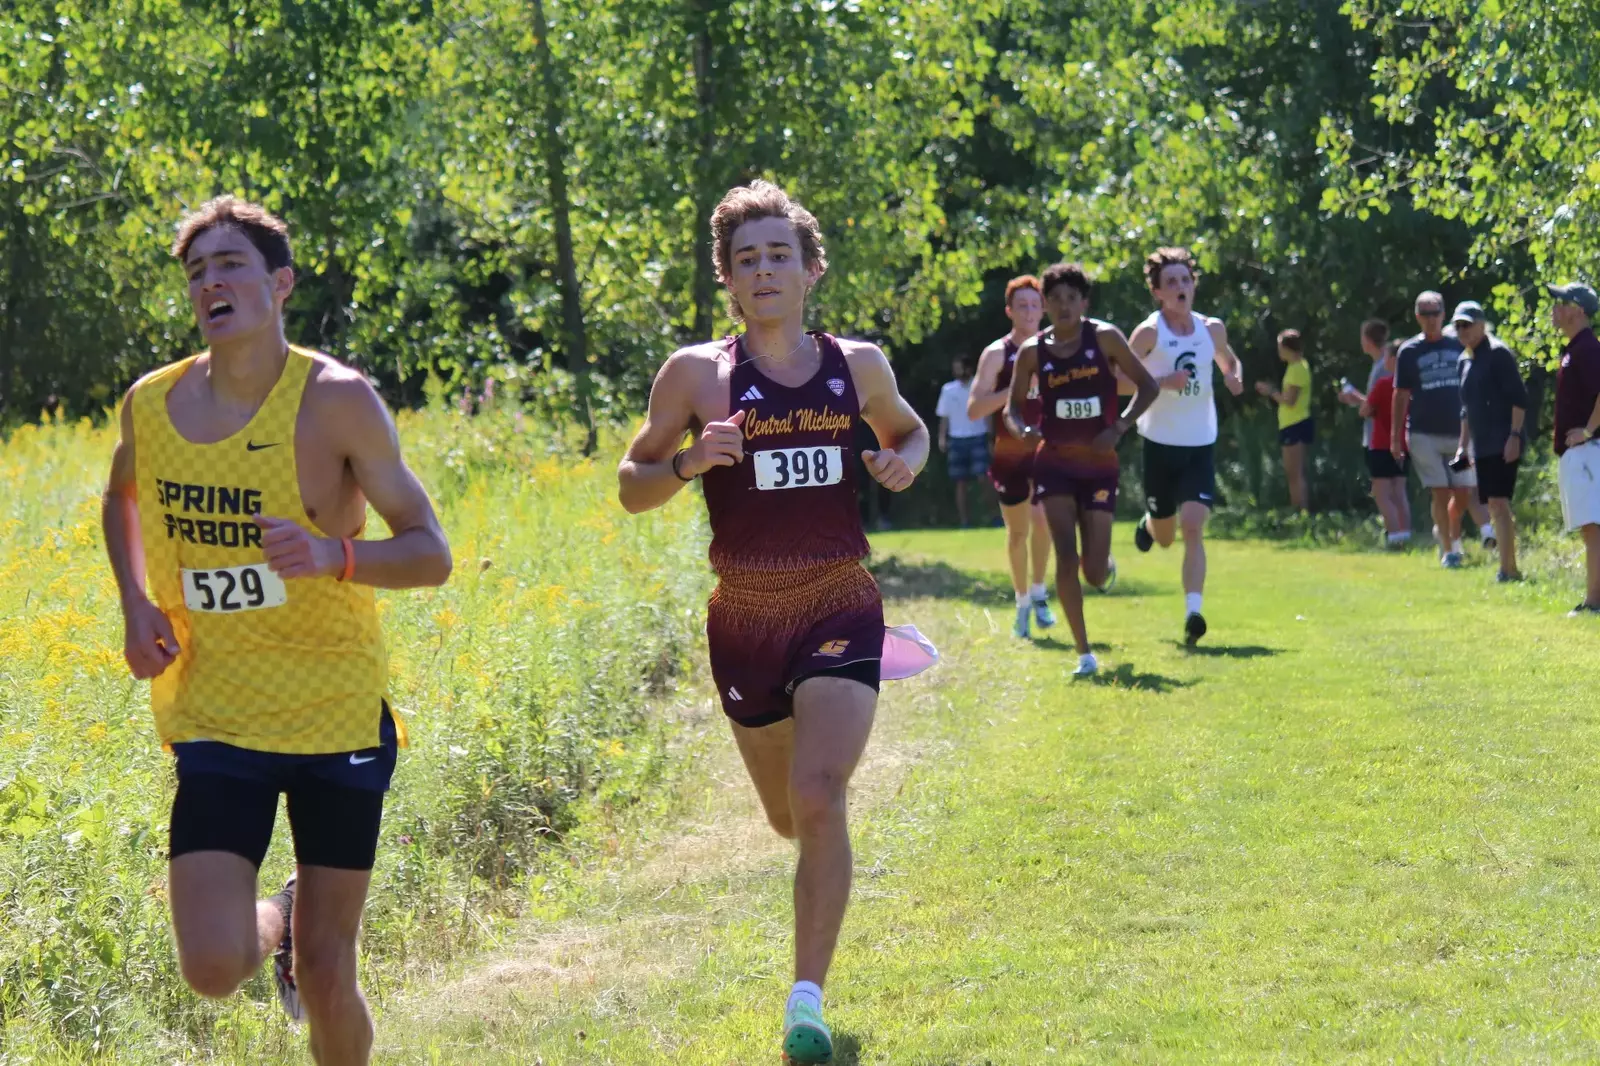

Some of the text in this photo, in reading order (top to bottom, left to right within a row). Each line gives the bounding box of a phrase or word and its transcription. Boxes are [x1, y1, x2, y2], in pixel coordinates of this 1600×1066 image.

[1178, 380, 1200, 397] 86
[745, 404, 851, 440] Central Michigan
[1064, 401, 1092, 419] 389
[771, 449, 828, 487] 398
[193, 568, 264, 610] 529
